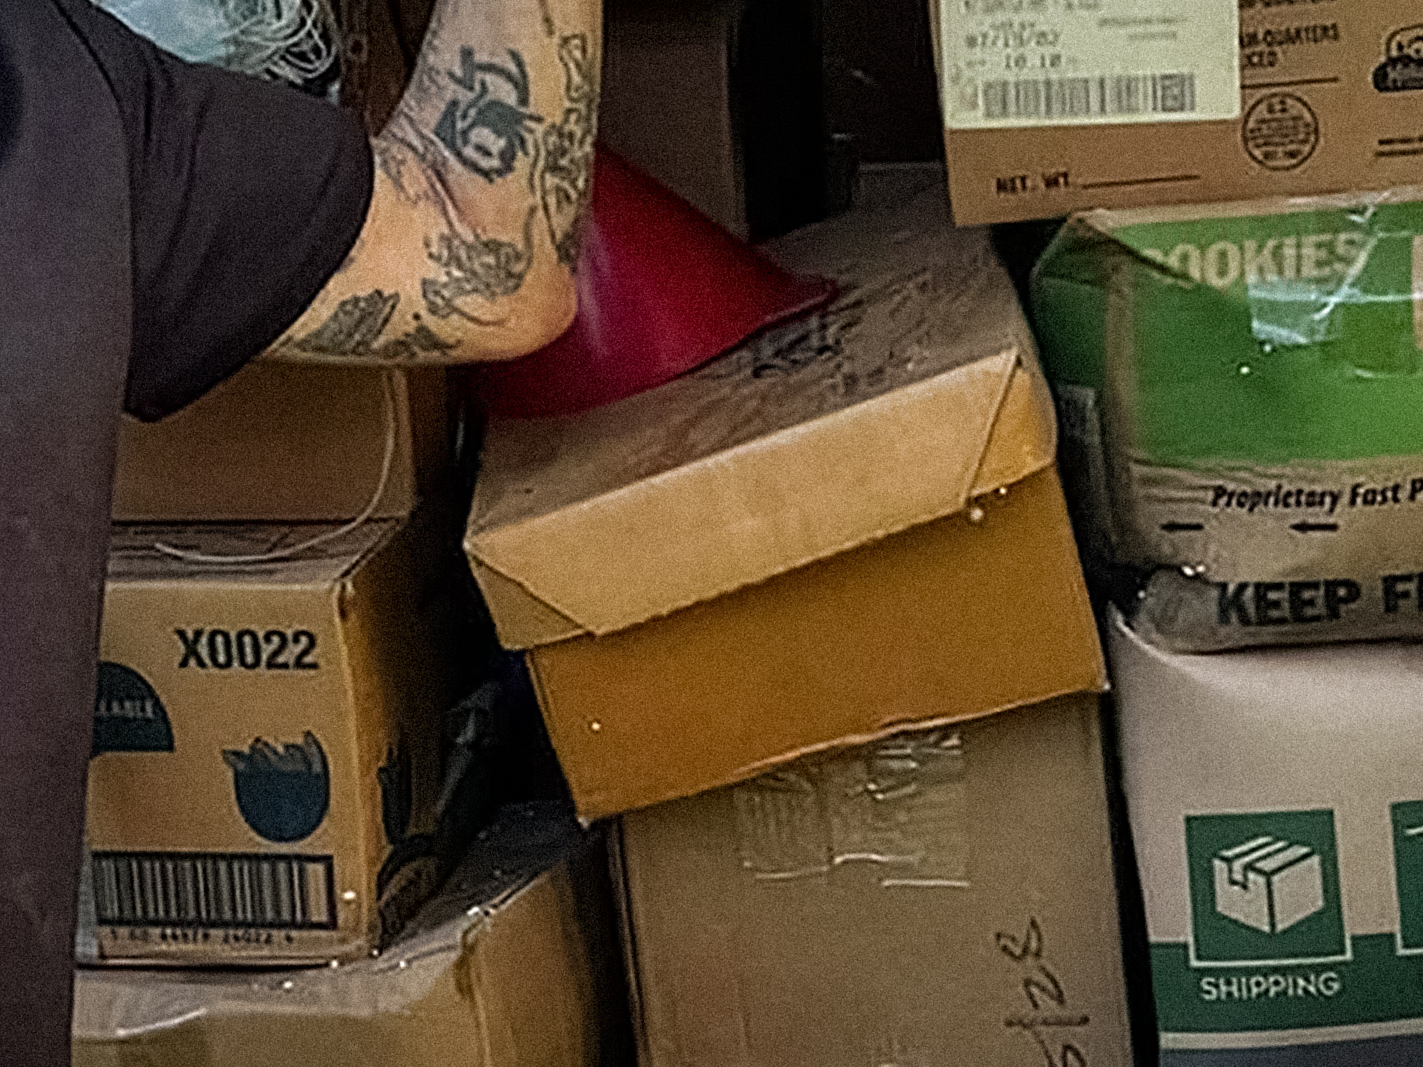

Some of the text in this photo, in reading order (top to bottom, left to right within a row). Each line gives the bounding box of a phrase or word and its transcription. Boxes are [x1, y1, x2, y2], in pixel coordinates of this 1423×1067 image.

[1209, 484, 1344, 516] Proprietary
[1349, 479, 1402, 508] Fast
[1216, 576, 1360, 628] KEEP
[174, 628, 319, 671] X0022
[1199, 971, 1341, 1001] SHIPPING
